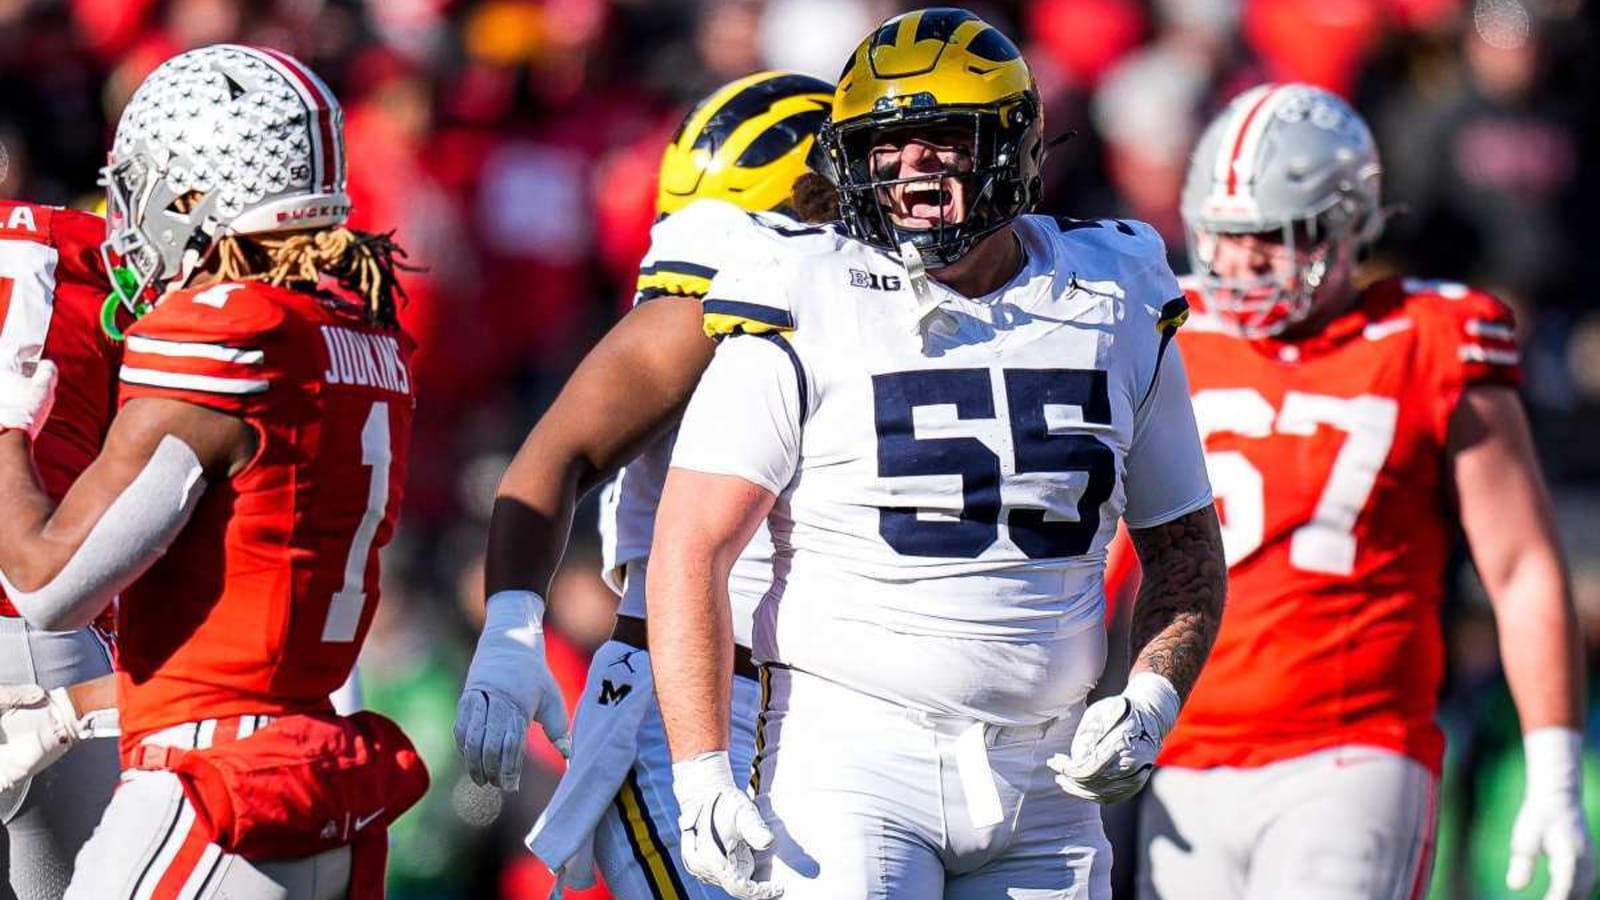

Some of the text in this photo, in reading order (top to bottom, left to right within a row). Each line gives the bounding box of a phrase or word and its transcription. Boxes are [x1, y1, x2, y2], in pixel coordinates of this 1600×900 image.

[320, 325, 409, 394] JUDKINS
[321, 402, 389, 642] 1
[872, 367, 1115, 558] 55
[1191, 388, 1398, 576] 67
[597, 679, 632, 707] M
